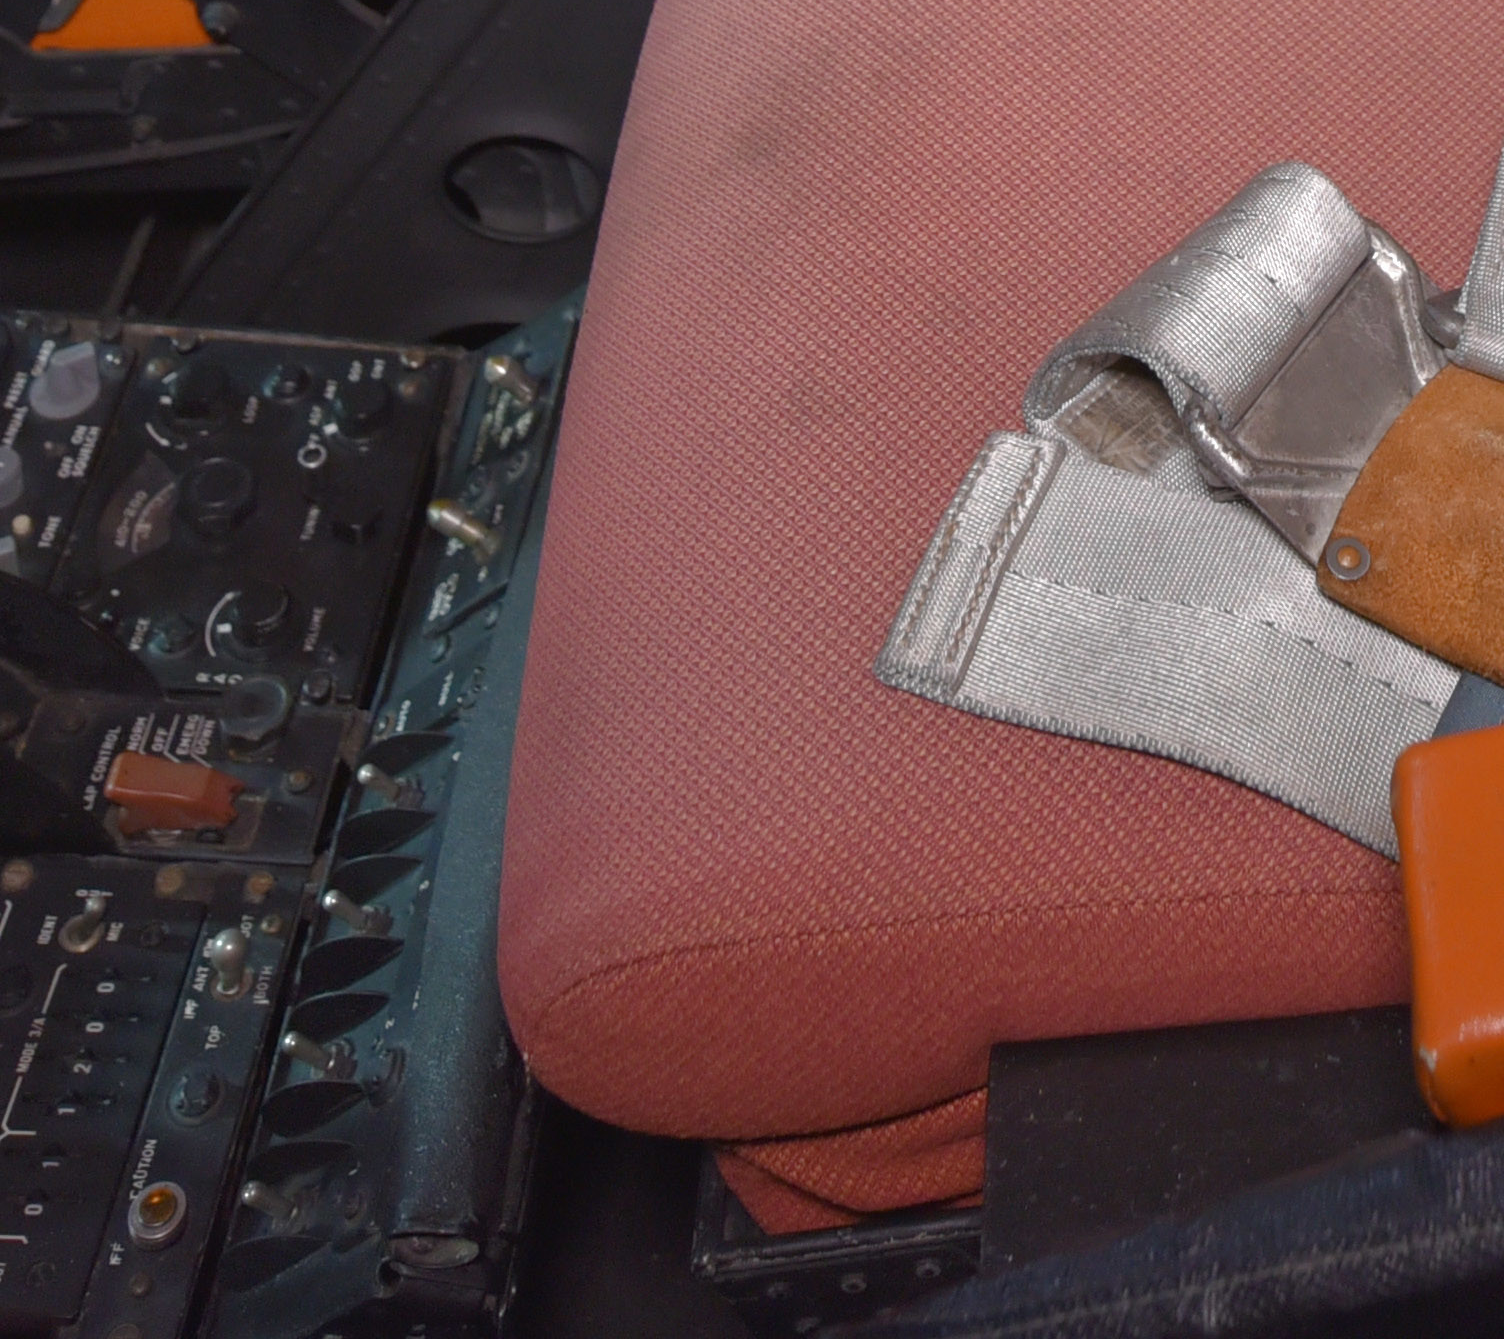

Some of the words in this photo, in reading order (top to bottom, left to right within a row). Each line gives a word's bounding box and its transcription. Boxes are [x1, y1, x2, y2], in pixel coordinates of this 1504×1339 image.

[3, 371, 27, 409] PRESET
[2, 406, 29, 447] ANUAL
[57, 456, 75, 479] OFF
[70, 425, 88, 445] ON
[71, 426, 101, 477] SQUELCH
[37, 515, 62, 548] TONE
[128, 617, 151, 651] VOICE
[303, 606, 327, 651] VOLUME
[126, 716, 148, 751] NORM
[151, 727, 168, 753] OFF
[175, 714, 200, 755] EMERG
[90, 726, 122, 782] CONTROL
[37, 915, 58, 945] IDENT
[106, 922, 124, 942] MIC
[96, 982, 115, 993] 0
[192, 966, 210, 992] ANT
[85, 1021, 104, 1033] 0
[205, 1025, 223, 1051] TOP
[16, 1042, 38, 1073] MODE
[28, 1017, 47, 1039] 3/A
[73, 1063, 92, 1074] 2
[24, 1203, 43, 1216] 0
